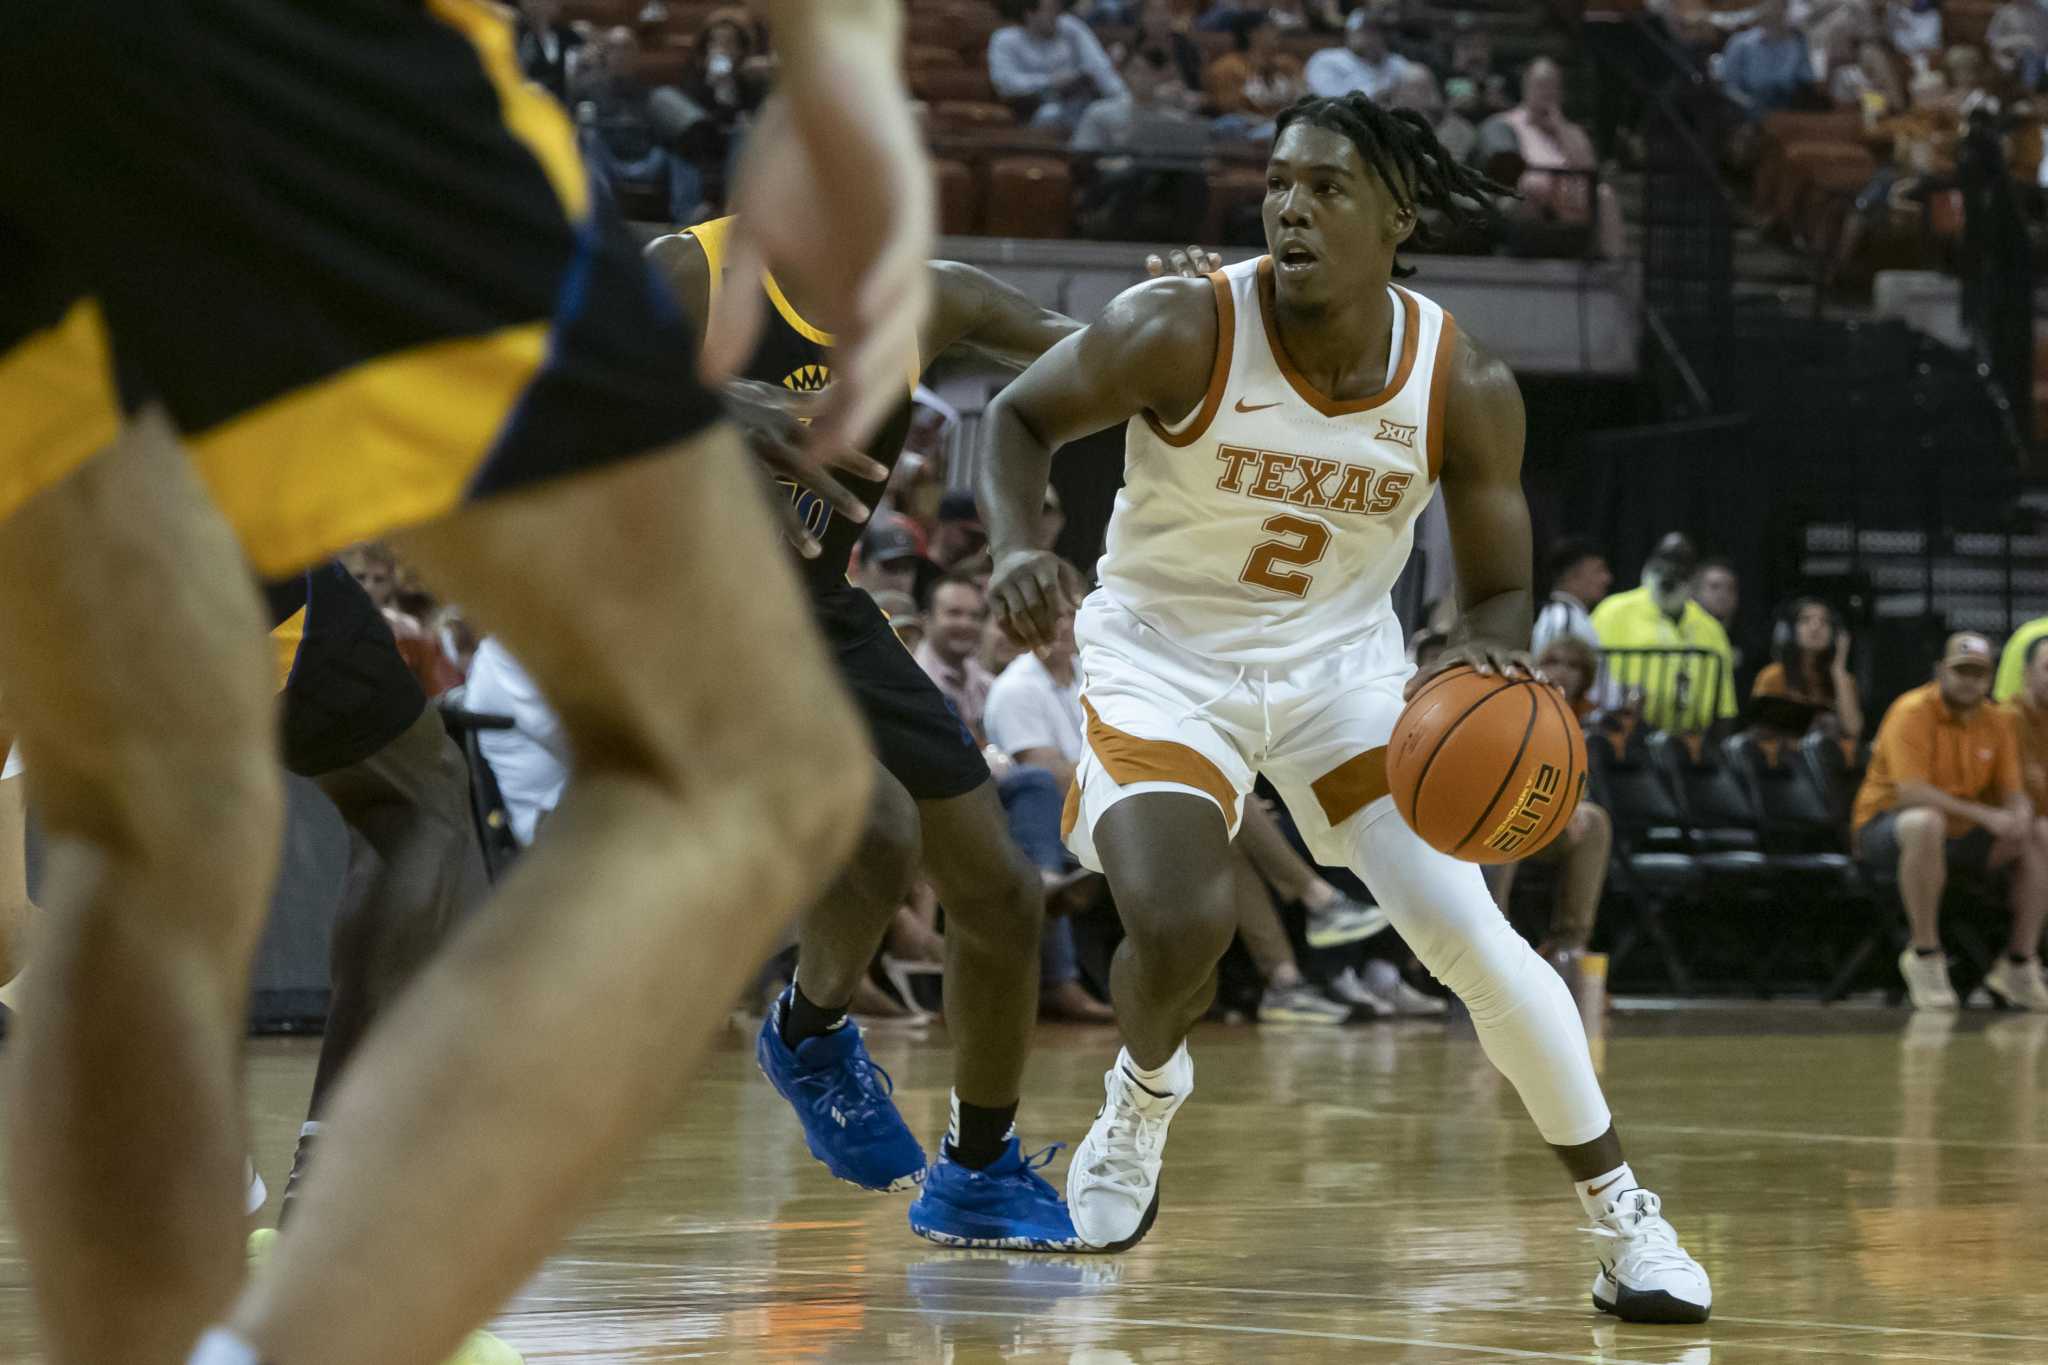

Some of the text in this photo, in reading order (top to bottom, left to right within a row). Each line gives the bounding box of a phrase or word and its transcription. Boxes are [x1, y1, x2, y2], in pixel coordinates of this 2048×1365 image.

[1216, 443, 1413, 515] TEXAS
[1239, 513, 1332, 599] 2
[1488, 762, 1561, 853] ELITE
